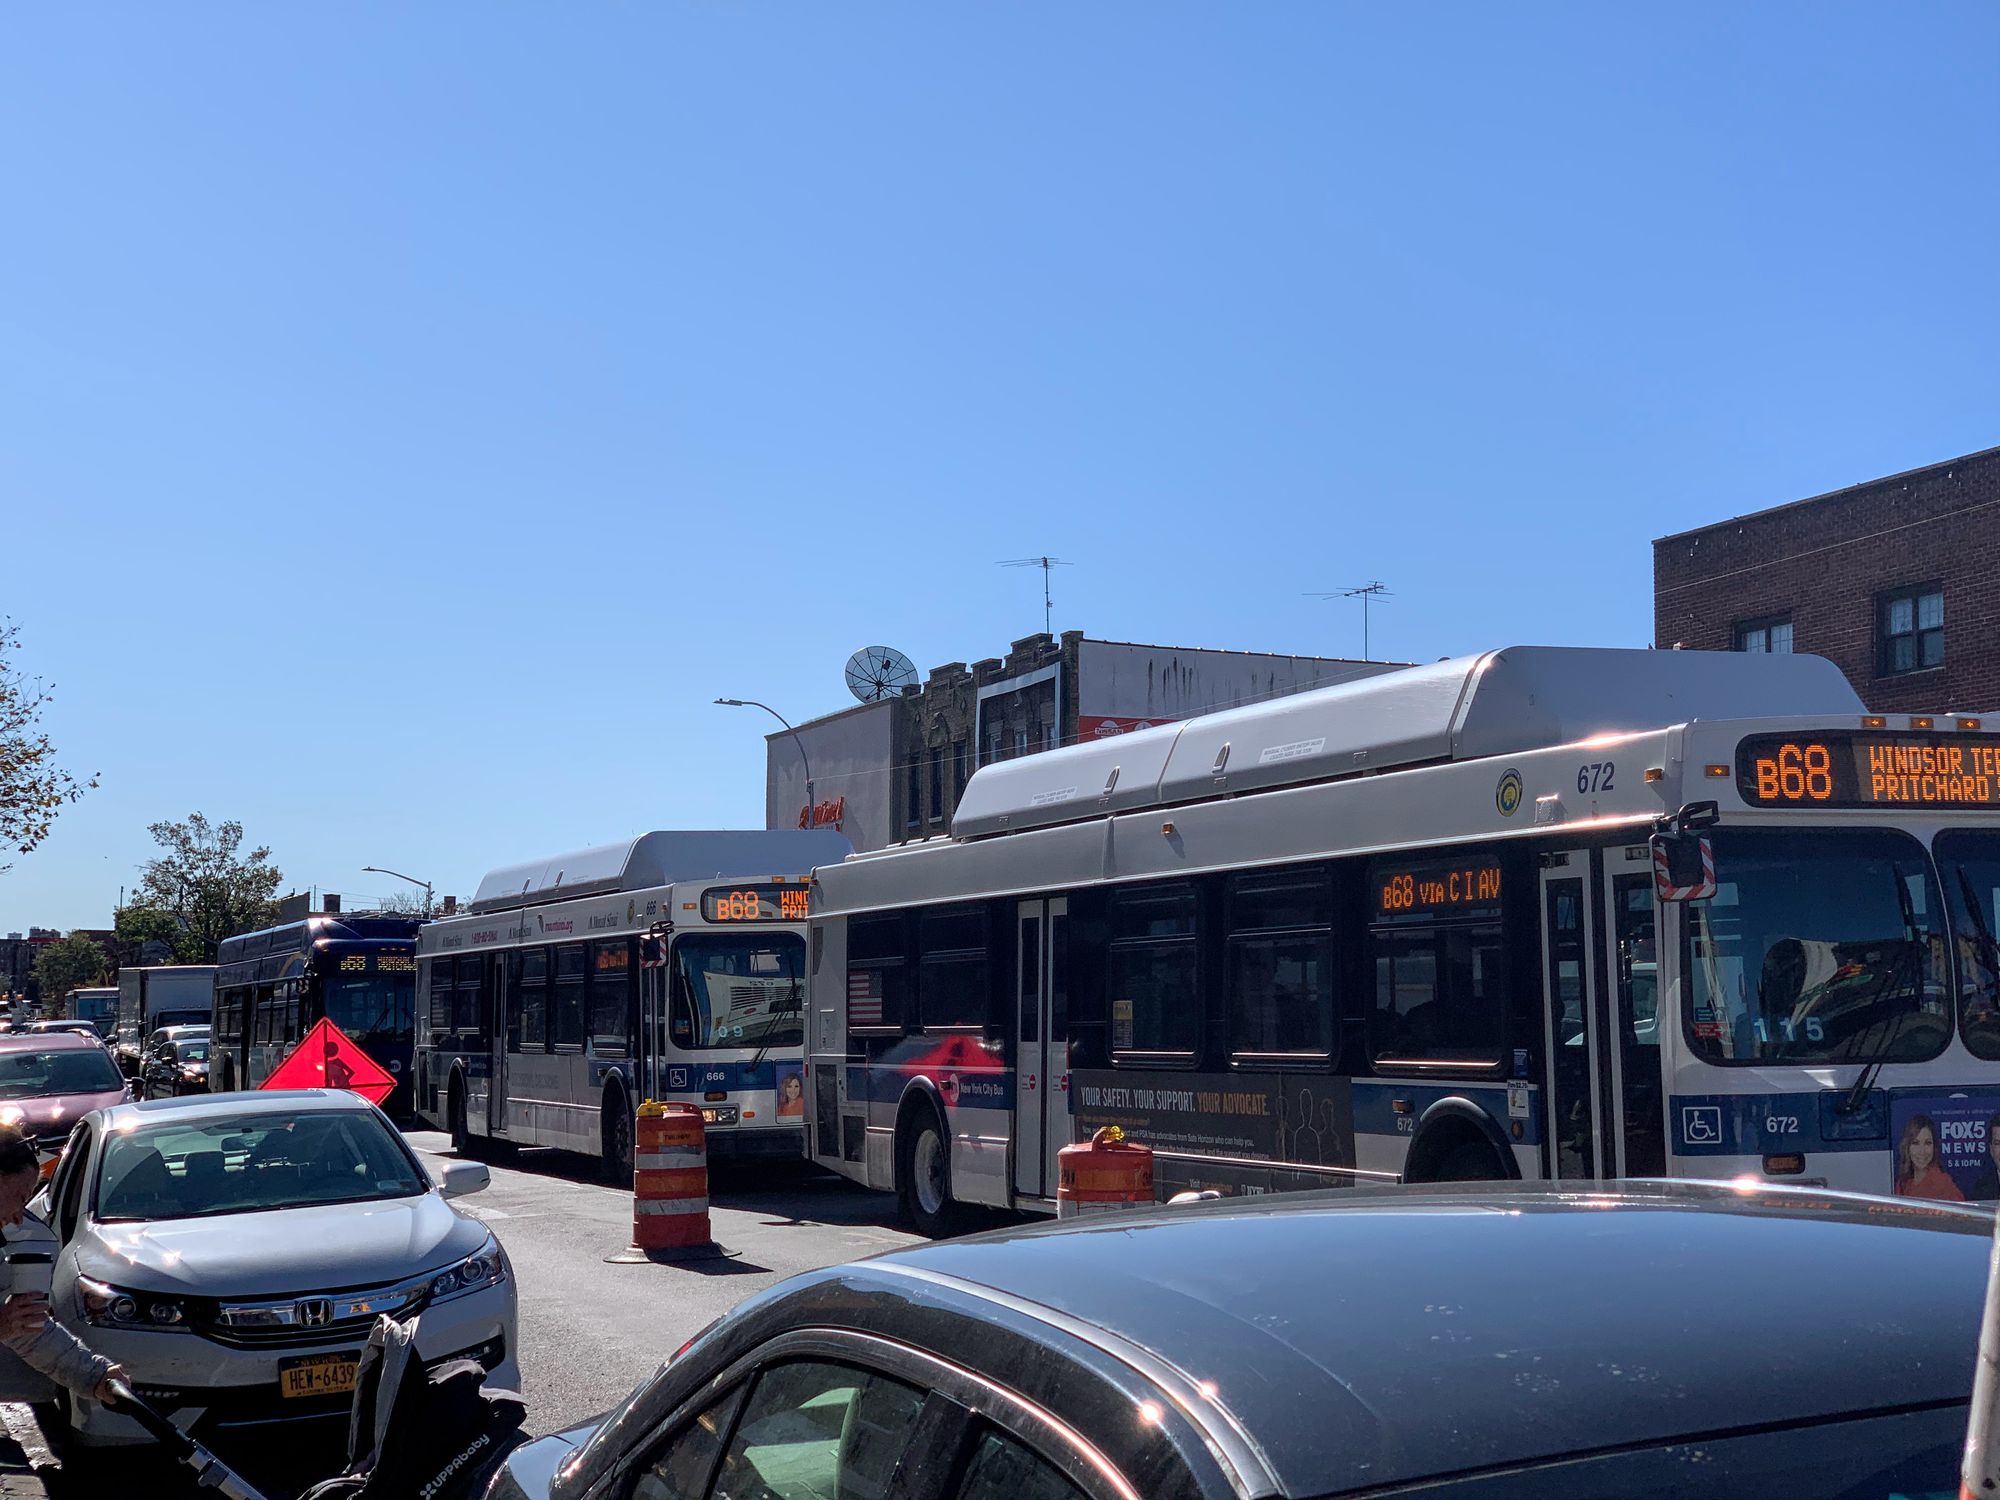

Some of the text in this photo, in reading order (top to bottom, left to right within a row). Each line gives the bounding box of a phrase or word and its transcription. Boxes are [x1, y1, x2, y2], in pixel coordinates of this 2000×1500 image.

[1756, 744, 1833, 799] B68
[1869, 746, 1963, 775] WINDSOR
[1577, 761, 1615, 794] 672
[1871, 775, 1990, 800] PRITCHARD
[1383, 868, 1501, 909] B68 VIA C I AV
[646, 900, 657, 916] 666
[717, 891, 759, 920] B68
[706, 1072, 725, 1081] 666
[960, 1083, 1004, 1096] New York City Bus
[1080, 1087, 1271, 1116] YOUR SAFETY. YOUR SUPPORT. YOUR ADVOCATE.
[1397, 1117, 1414, 1131] 672
[1766, 1116, 1799, 1133] 672
[1942, 1142, 1986, 1154] NEWS
